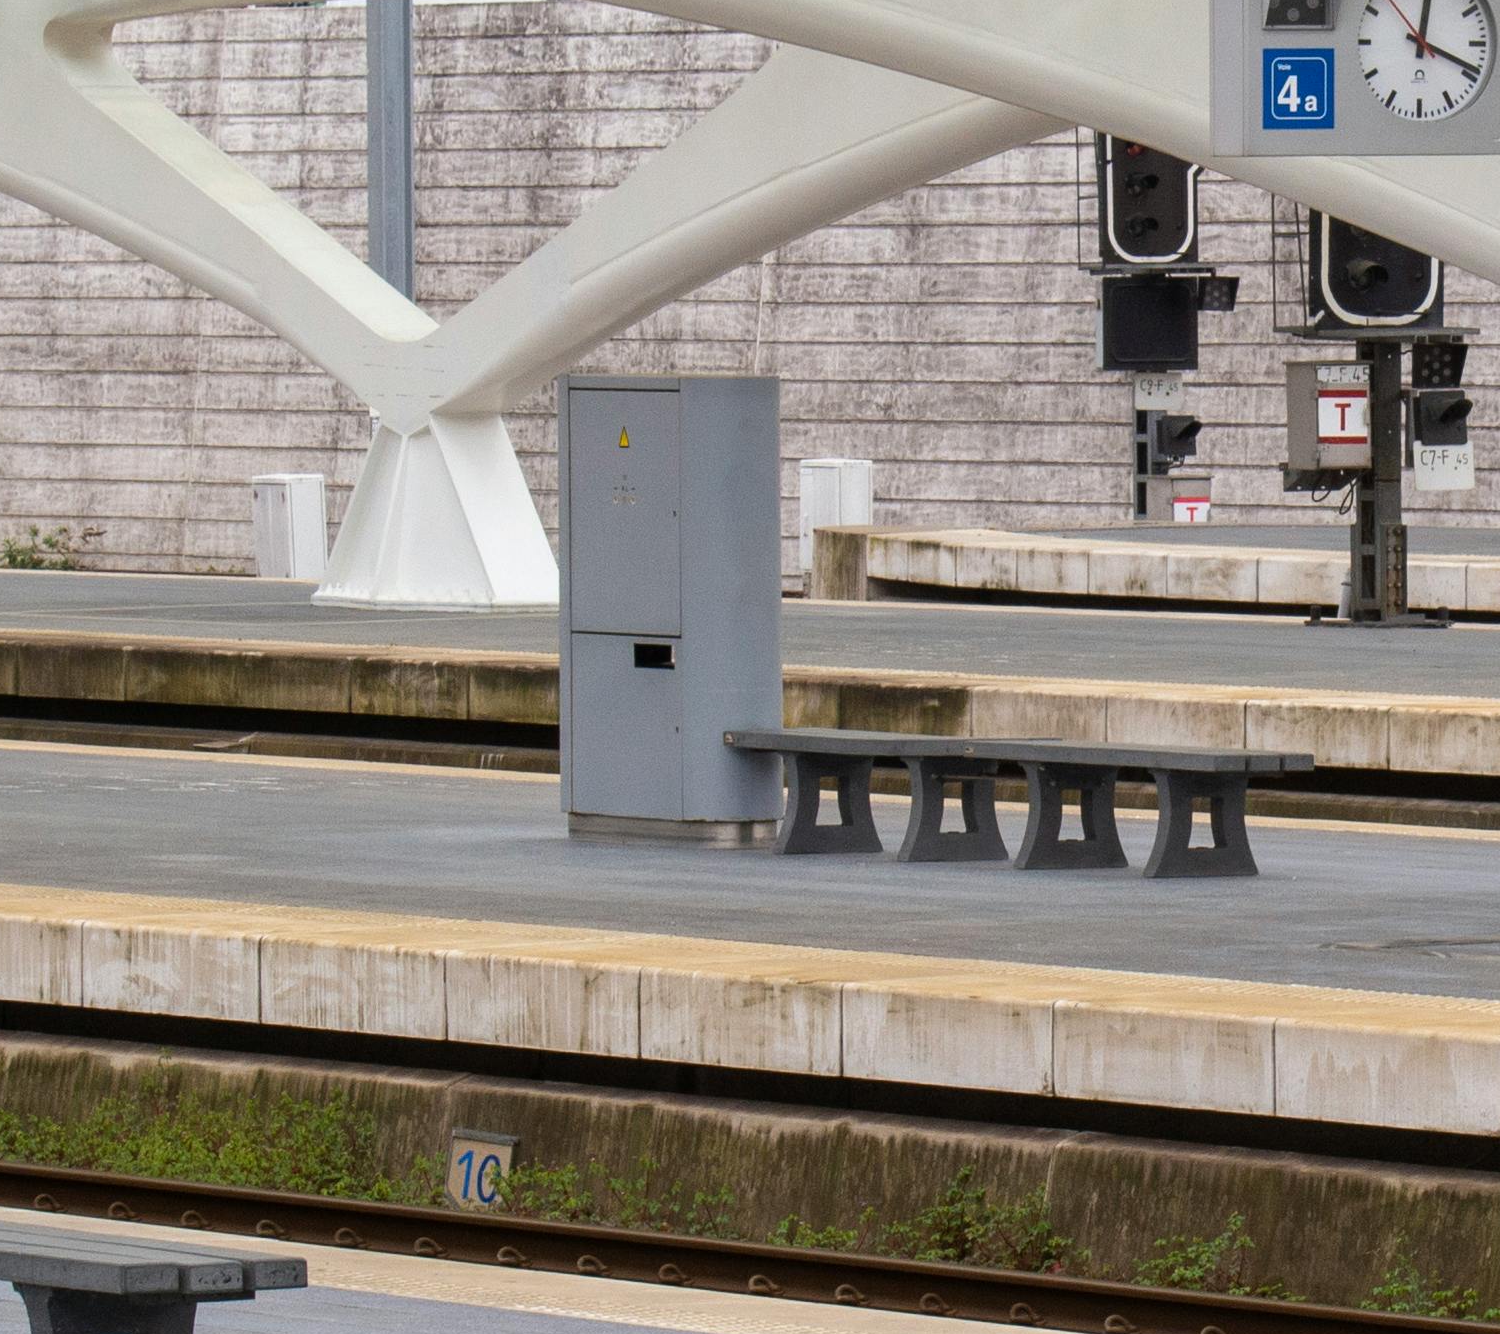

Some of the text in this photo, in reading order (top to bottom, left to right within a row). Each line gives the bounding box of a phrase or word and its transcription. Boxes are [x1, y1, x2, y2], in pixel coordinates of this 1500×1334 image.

[1334, 403, 1351, 431] T
[1420, 450, 1469, 466] C7-F 45
[458, 1150, 501, 1204] 10
